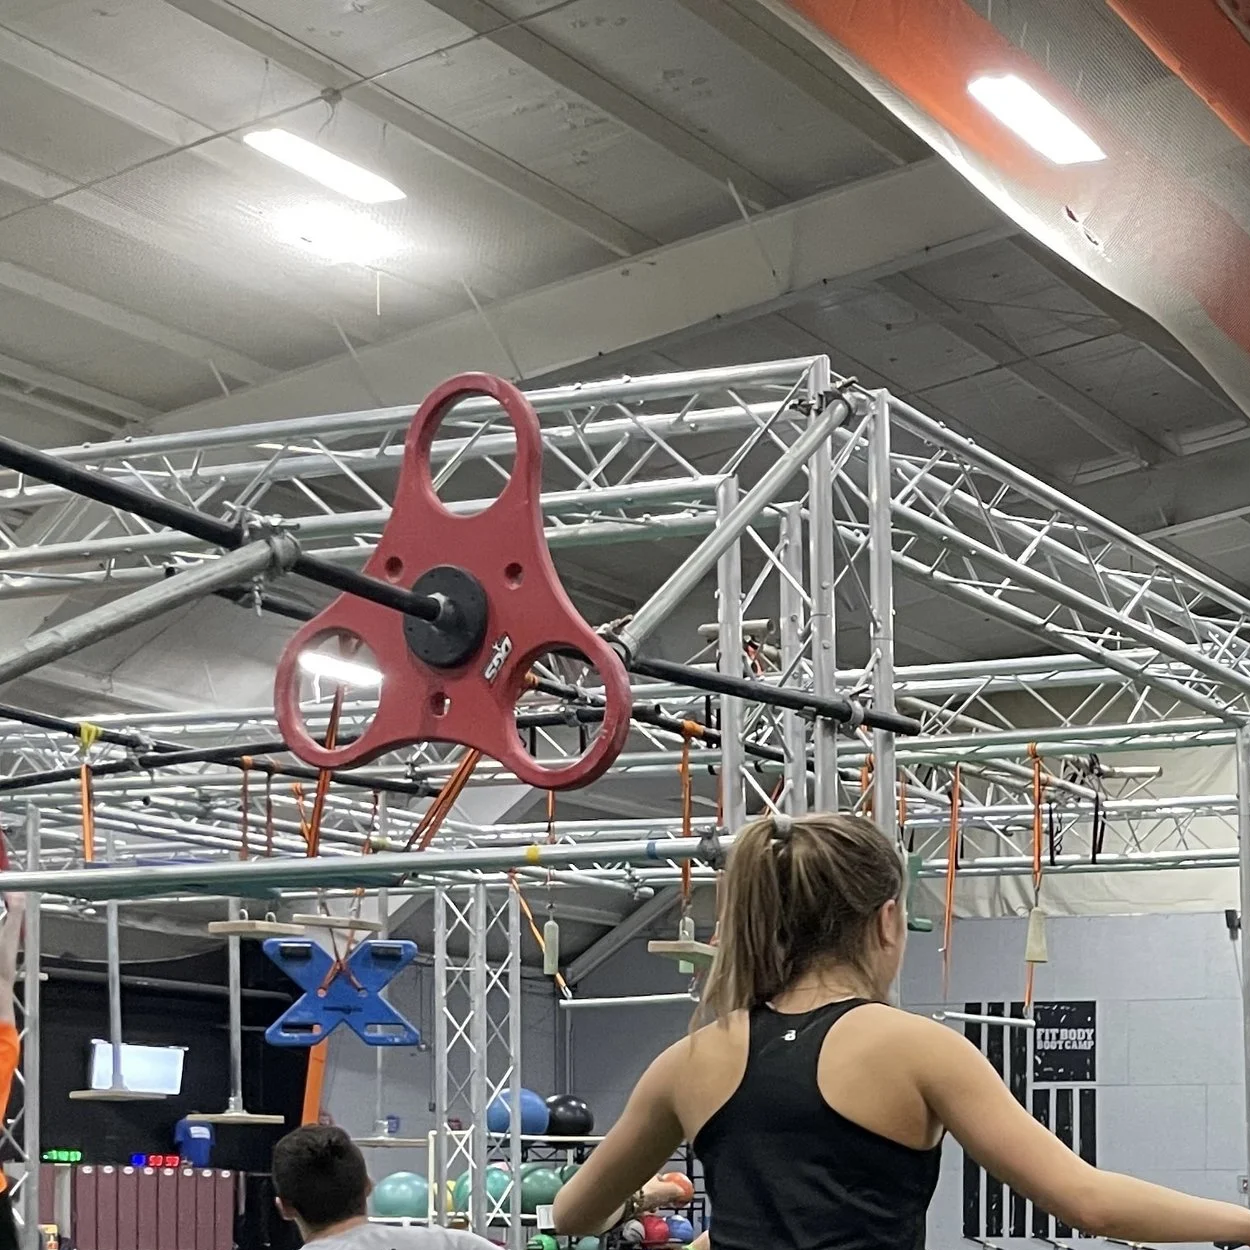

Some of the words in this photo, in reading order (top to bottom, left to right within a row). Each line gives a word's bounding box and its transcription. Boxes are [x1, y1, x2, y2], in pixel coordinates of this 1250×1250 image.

[1036, 1028, 1059, 1040] FIT
[1060, 1028, 1094, 1040] BODY
[1036, 1040, 1063, 1050] BOOT
[1064, 1040, 1095, 1050] CAMP
